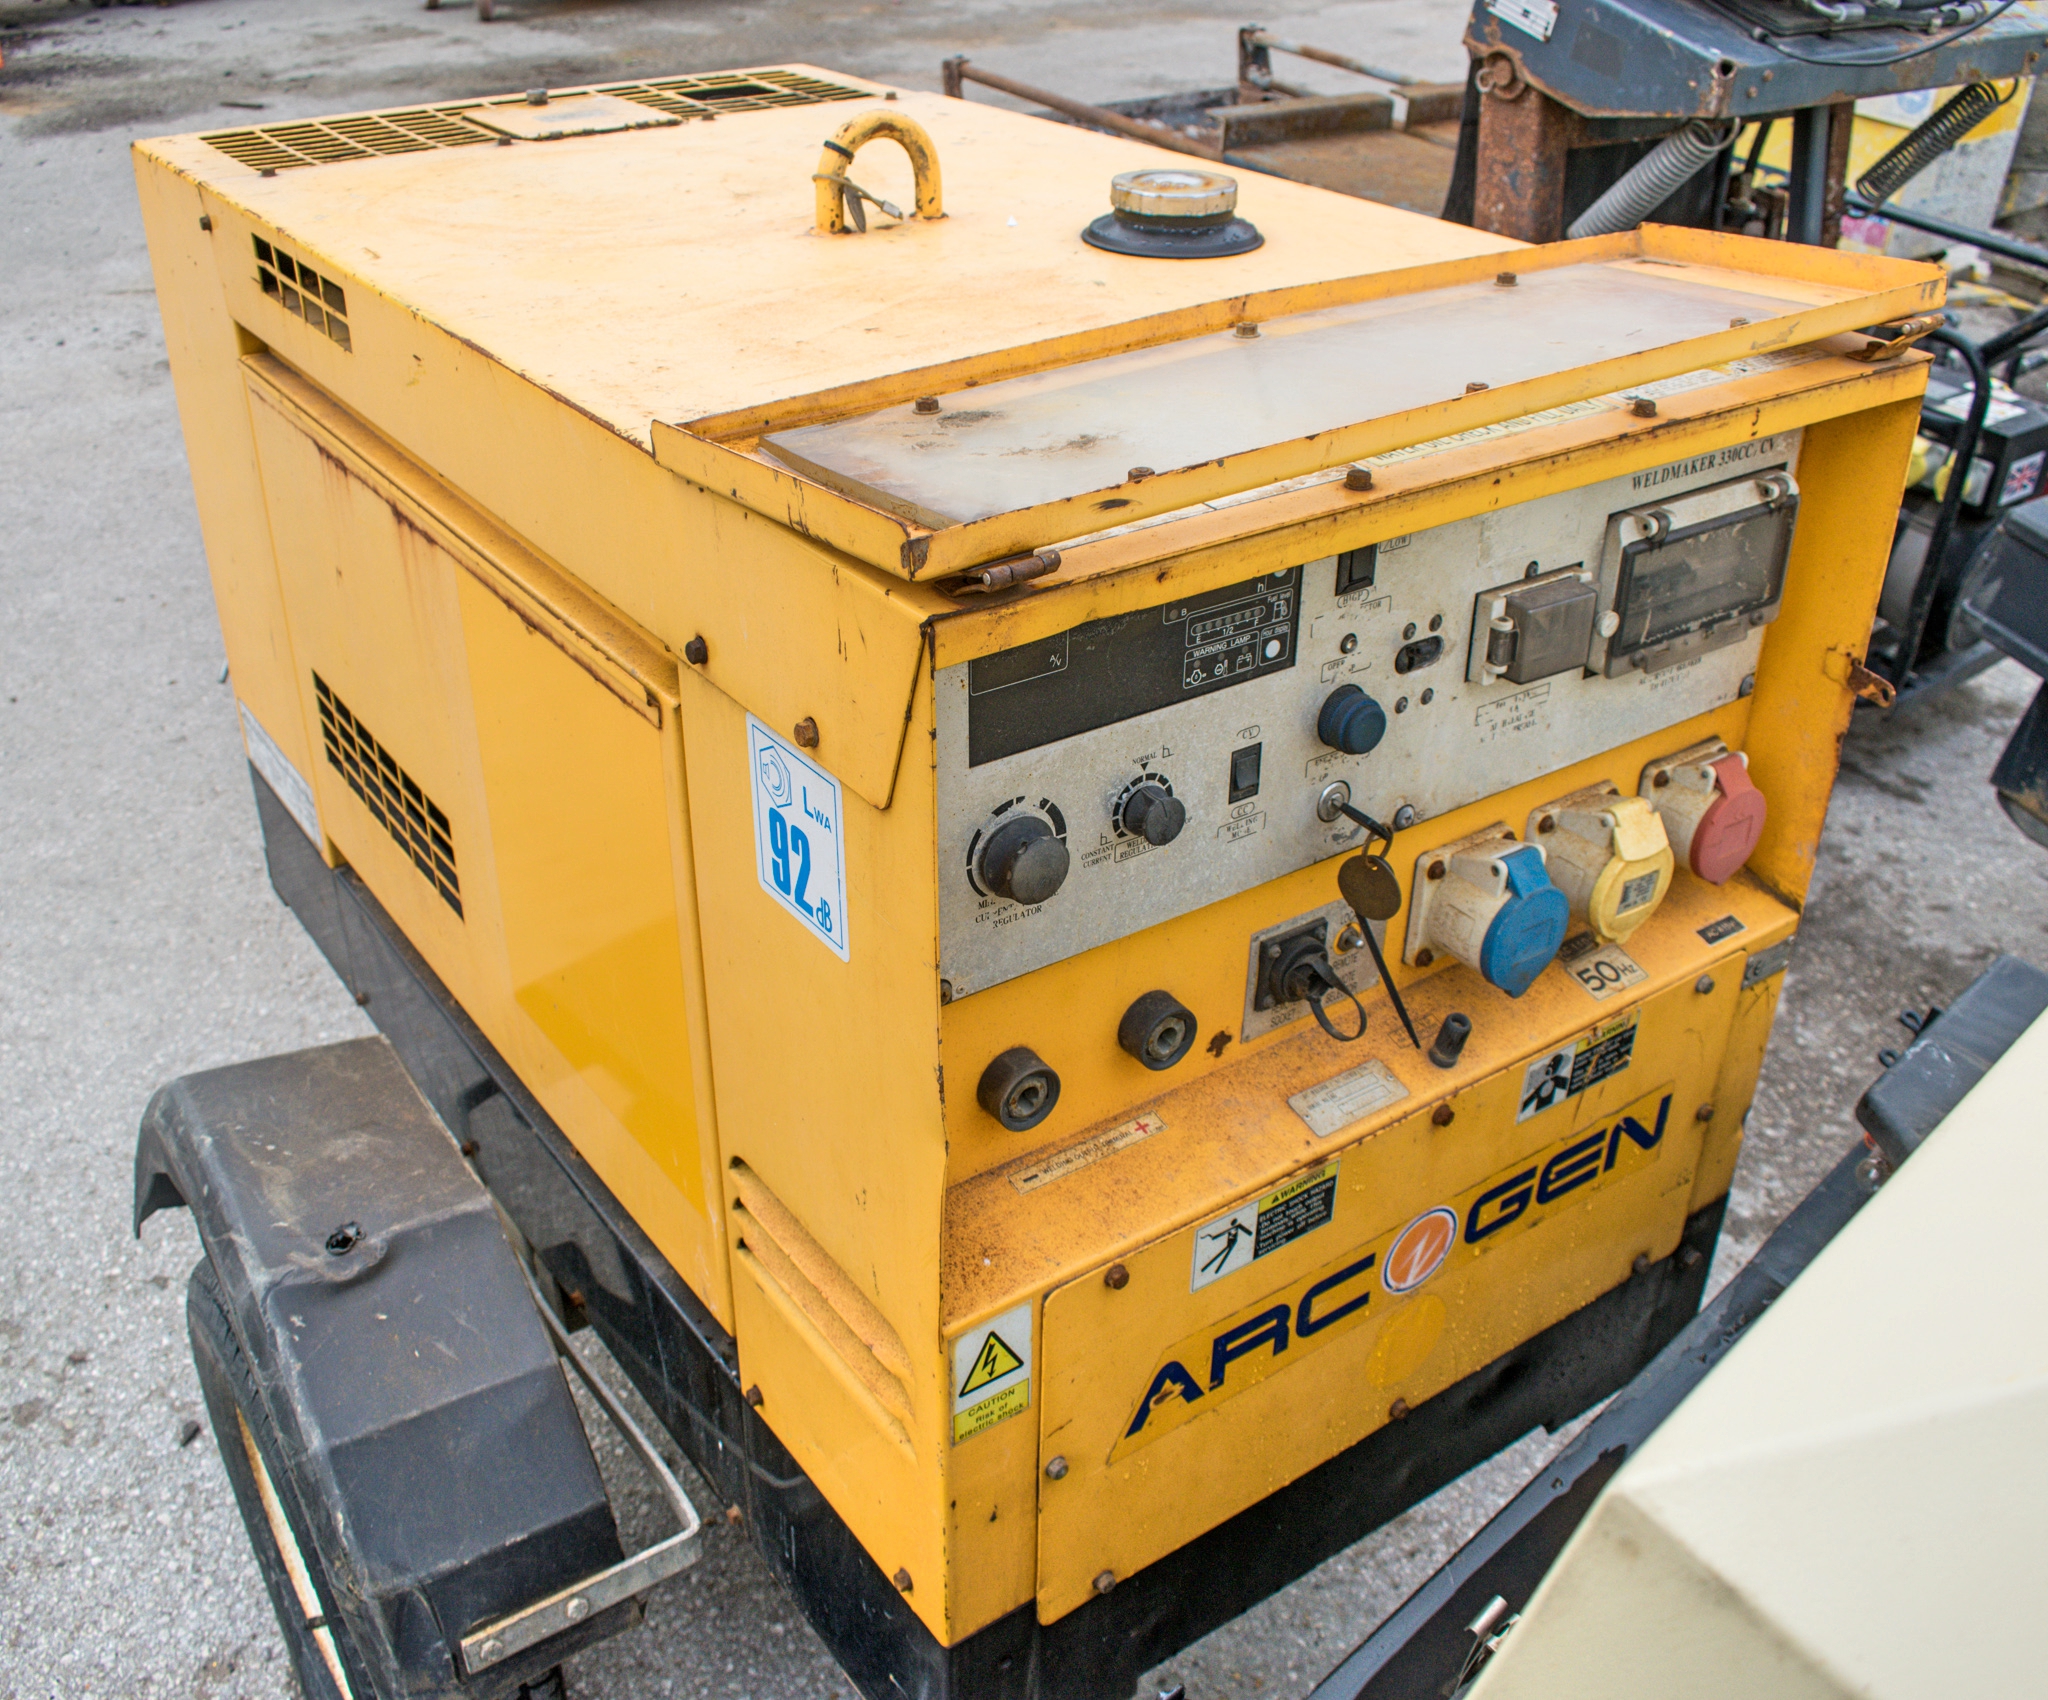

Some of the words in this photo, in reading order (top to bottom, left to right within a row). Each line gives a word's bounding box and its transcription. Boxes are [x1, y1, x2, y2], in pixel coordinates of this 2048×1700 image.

[1632, 454, 1716, 491] WELDMAKER
[1193, 641, 1228, 658] WARNING
[1230, 634, 1252, 647] LAMP
[1222, 626, 1235, 637] 1/2
[1132, 752, 1158, 766] NORMAL
[1081, 844, 1115, 861] CONSTANT
[769, 807, 814, 918] 92
[816, 897, 833, 933] dB
[1576, 960, 1622, 992] 50
[1618, 962, 1639, 977] Hz
[1042, 1158, 1074, 1176] WELDING
[1281, 1169, 1326, 1200] WARNING
[1125, 1253, 1377, 1438] ARC
[1464, 1094, 1673, 1244] GEN
[968, 1388, 1016, 1418] CAUTION
[975, 1410, 995, 1424] Risk
[999, 1402, 1009, 1412] of
[958, 1417, 994, 1440] electric
[997, 1403, 1024, 1421] shock
